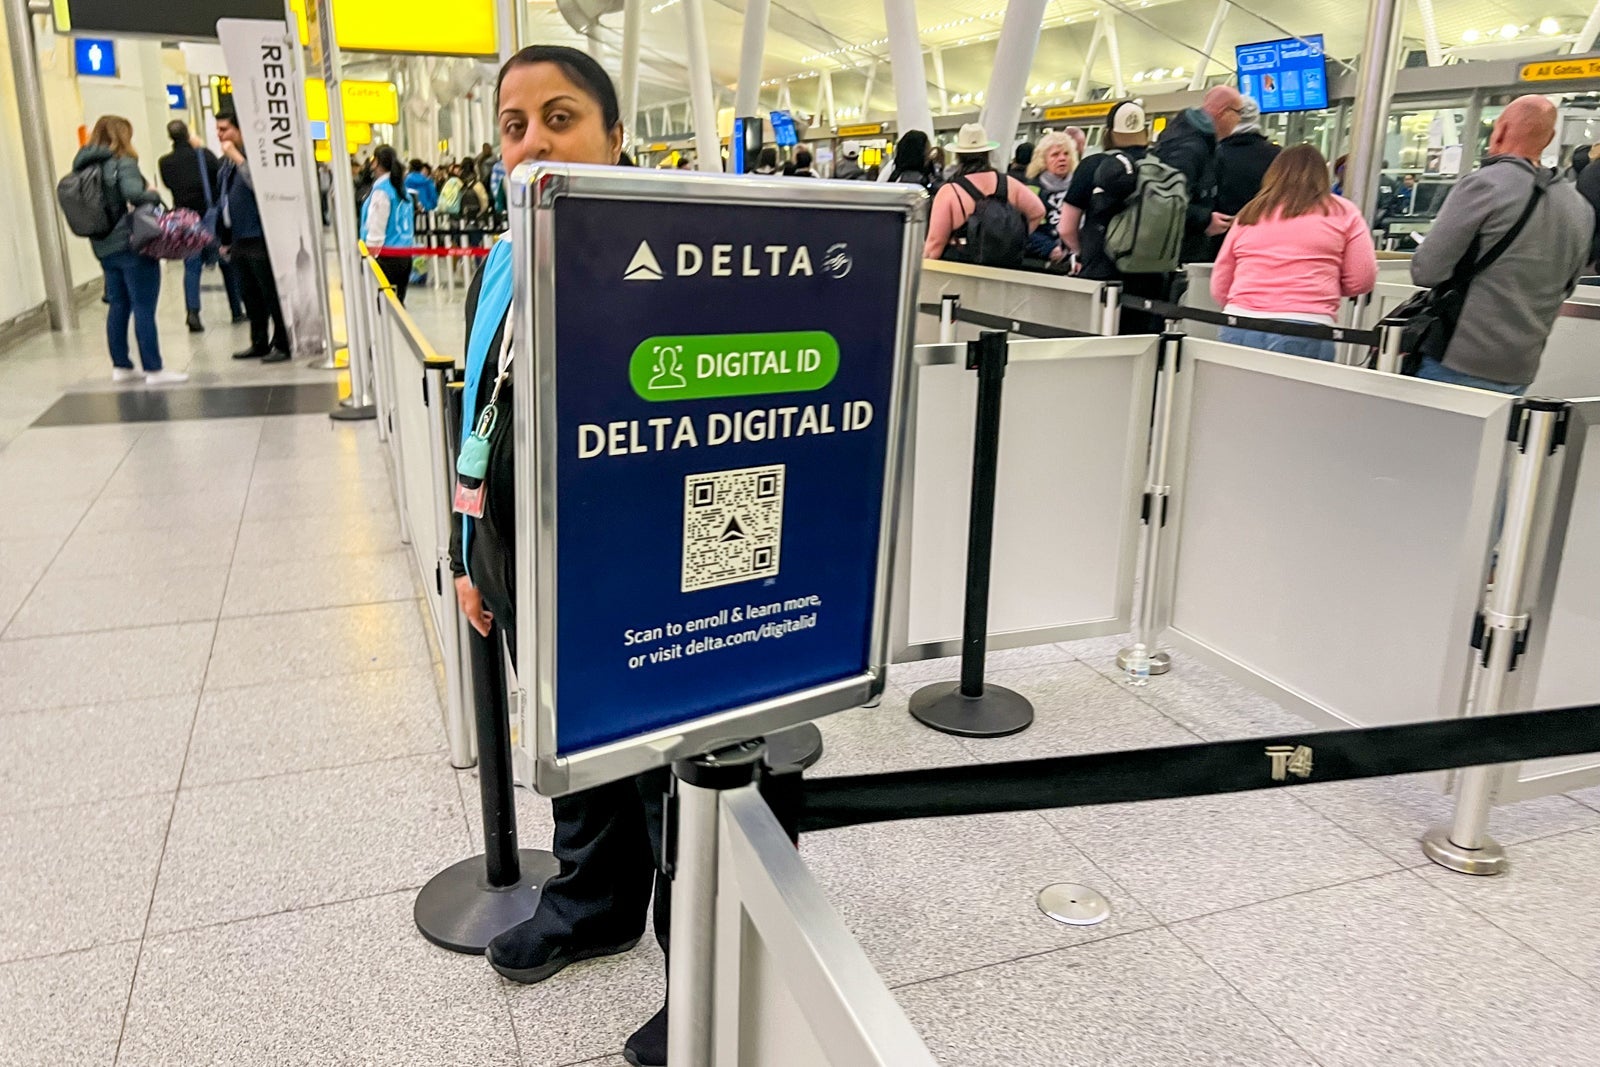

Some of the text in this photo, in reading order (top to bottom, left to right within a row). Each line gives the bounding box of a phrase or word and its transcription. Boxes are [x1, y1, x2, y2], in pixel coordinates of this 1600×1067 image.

[261, 45, 295, 168] RESERVE
[347, 86, 381, 98] Gates
[677, 243, 814, 277] DELTA
[696, 348, 821, 379] DIGITAL ID
[577, 400, 874, 459] DELTA DIGITAL ID
[624, 594, 822, 646] Scan to enroll & learn more,
[628, 612, 818, 669] or visit delta.com/digitalid
[1264, 744, 1314, 781] T4
